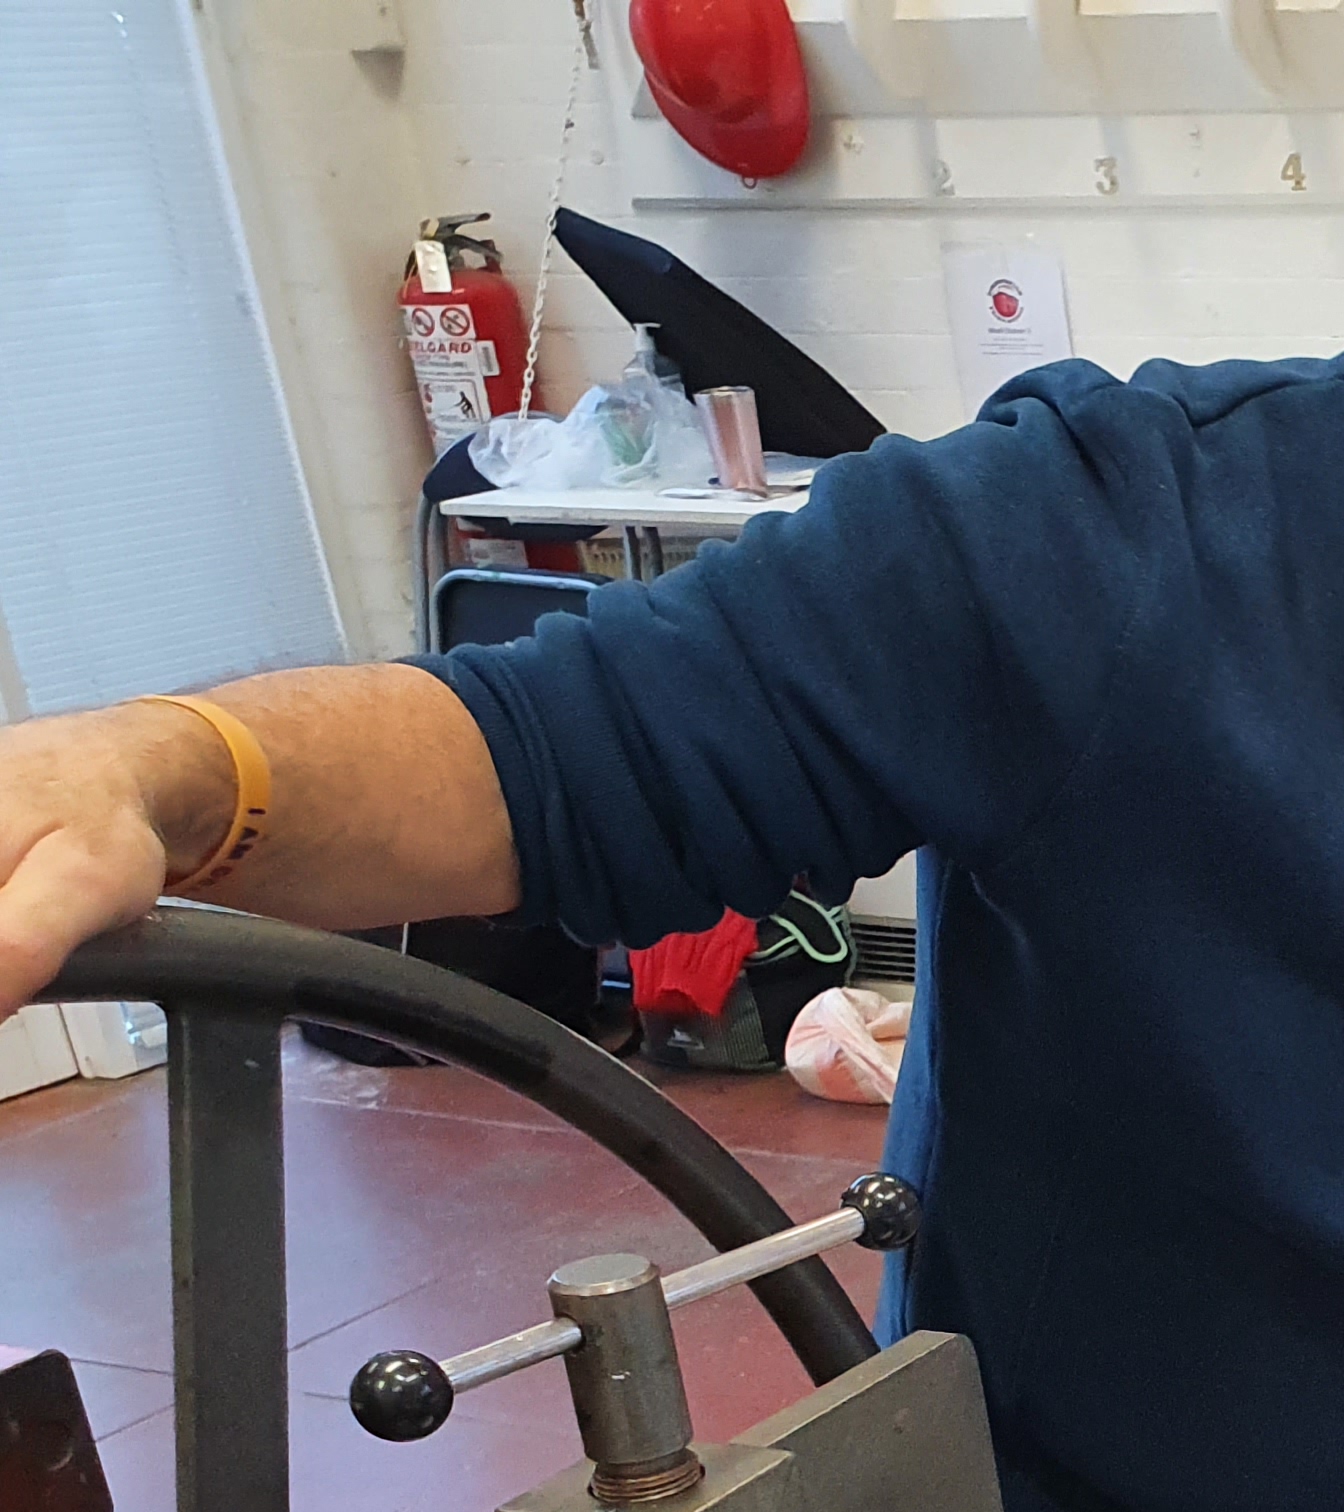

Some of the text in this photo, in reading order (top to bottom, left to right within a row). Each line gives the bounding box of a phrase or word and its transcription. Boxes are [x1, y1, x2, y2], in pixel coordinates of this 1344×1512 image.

[932, 160, 955, 196] 2
[1094, 156, 1119, 195] 3
[1280, 152, 1307, 191] 4
